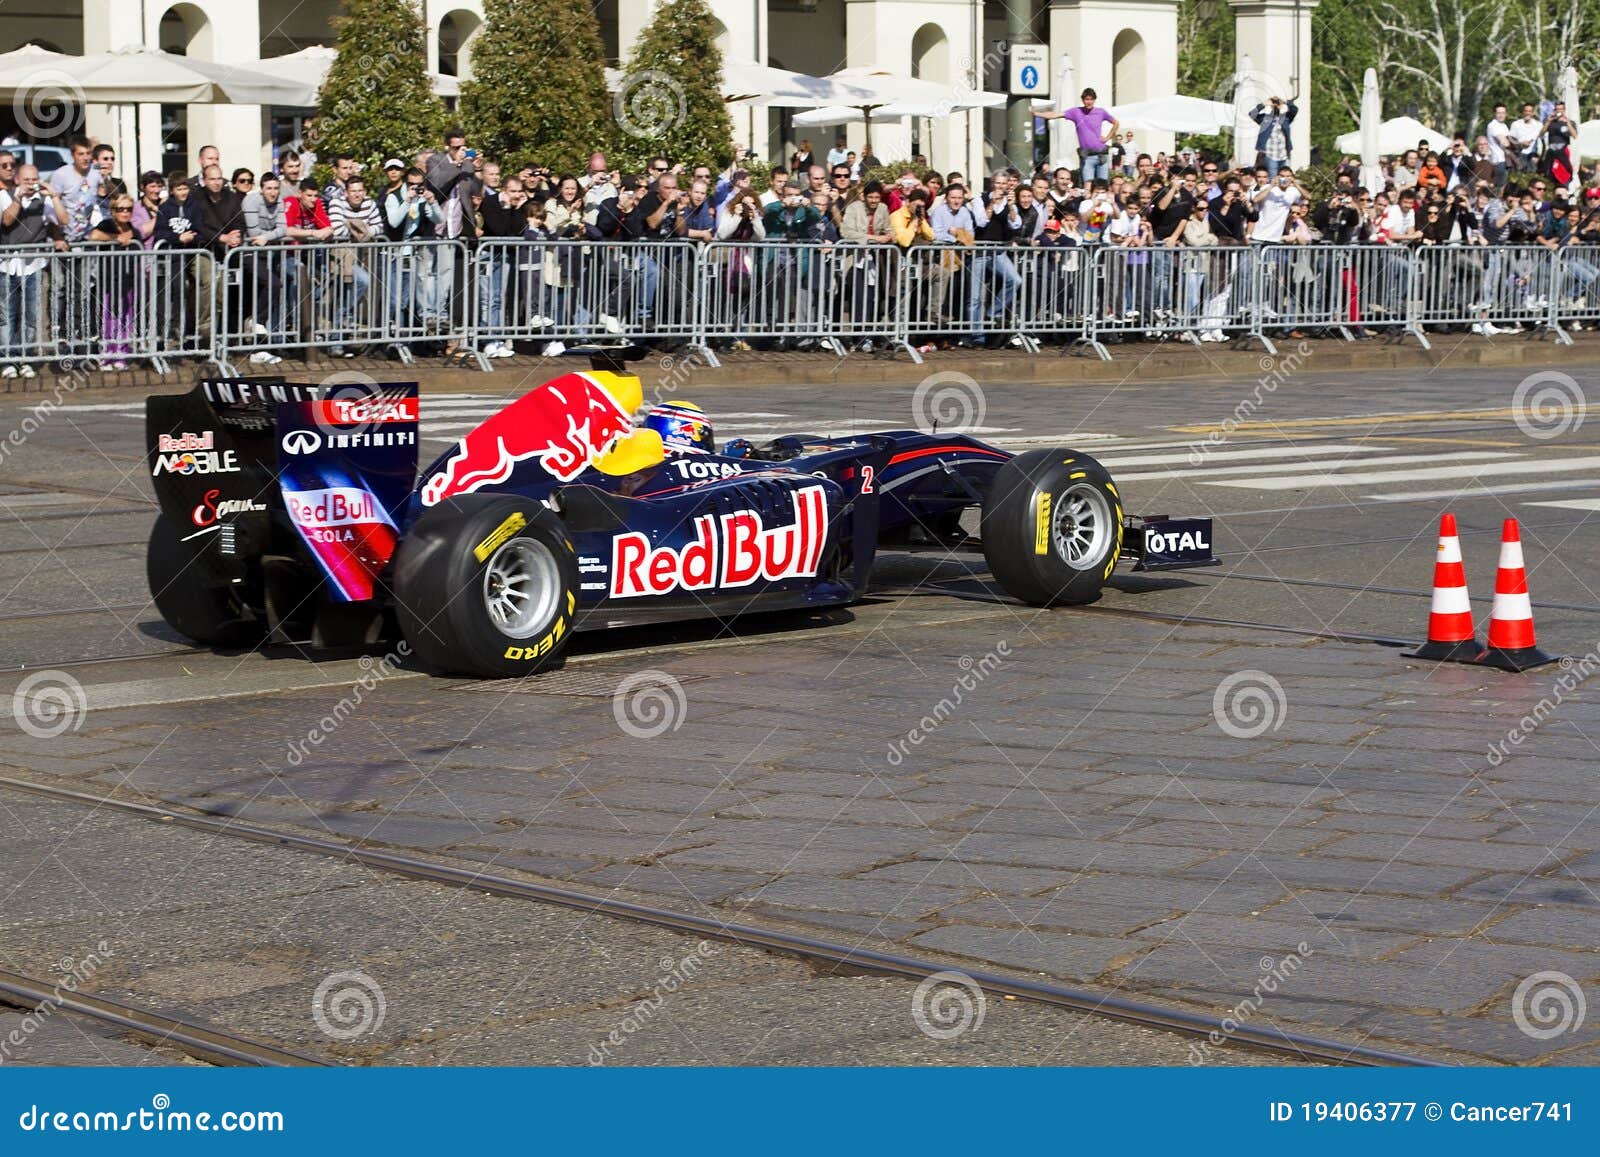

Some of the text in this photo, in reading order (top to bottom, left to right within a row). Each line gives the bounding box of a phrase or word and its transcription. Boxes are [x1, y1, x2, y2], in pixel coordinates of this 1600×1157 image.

[327, 431, 415, 449] INFINITI
[152, 450, 241, 476] MOBILE
[671, 459, 745, 479] TOTAL
[861, 466, 874, 494] 2
[1145, 529, 1209, 553] TOTAL
